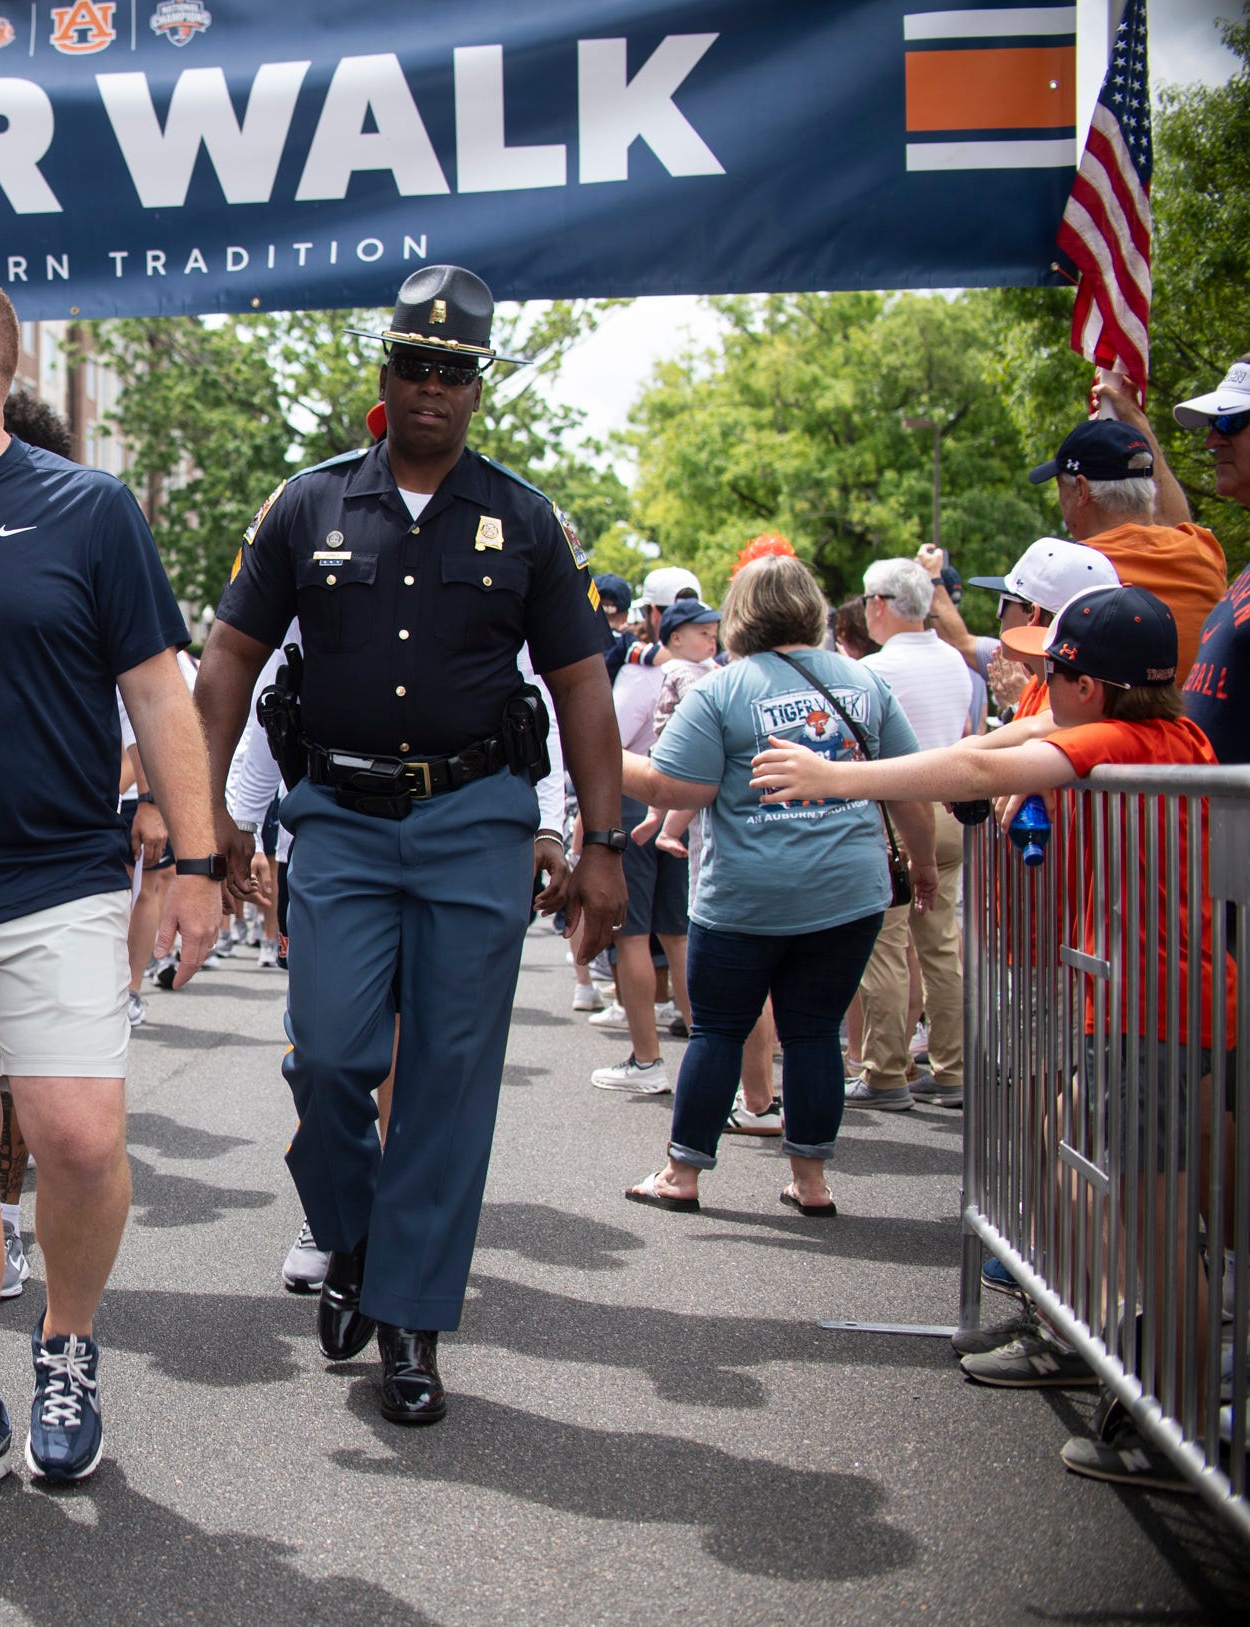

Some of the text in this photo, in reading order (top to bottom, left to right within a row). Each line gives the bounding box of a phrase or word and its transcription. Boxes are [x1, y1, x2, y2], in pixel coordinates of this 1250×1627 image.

[95, 33, 726, 209] WALK
[109, 234, 429, 278] TRADITION
[764, 692, 863, 727] TIGER WK
[764, 810, 816, 823] AUBURN
